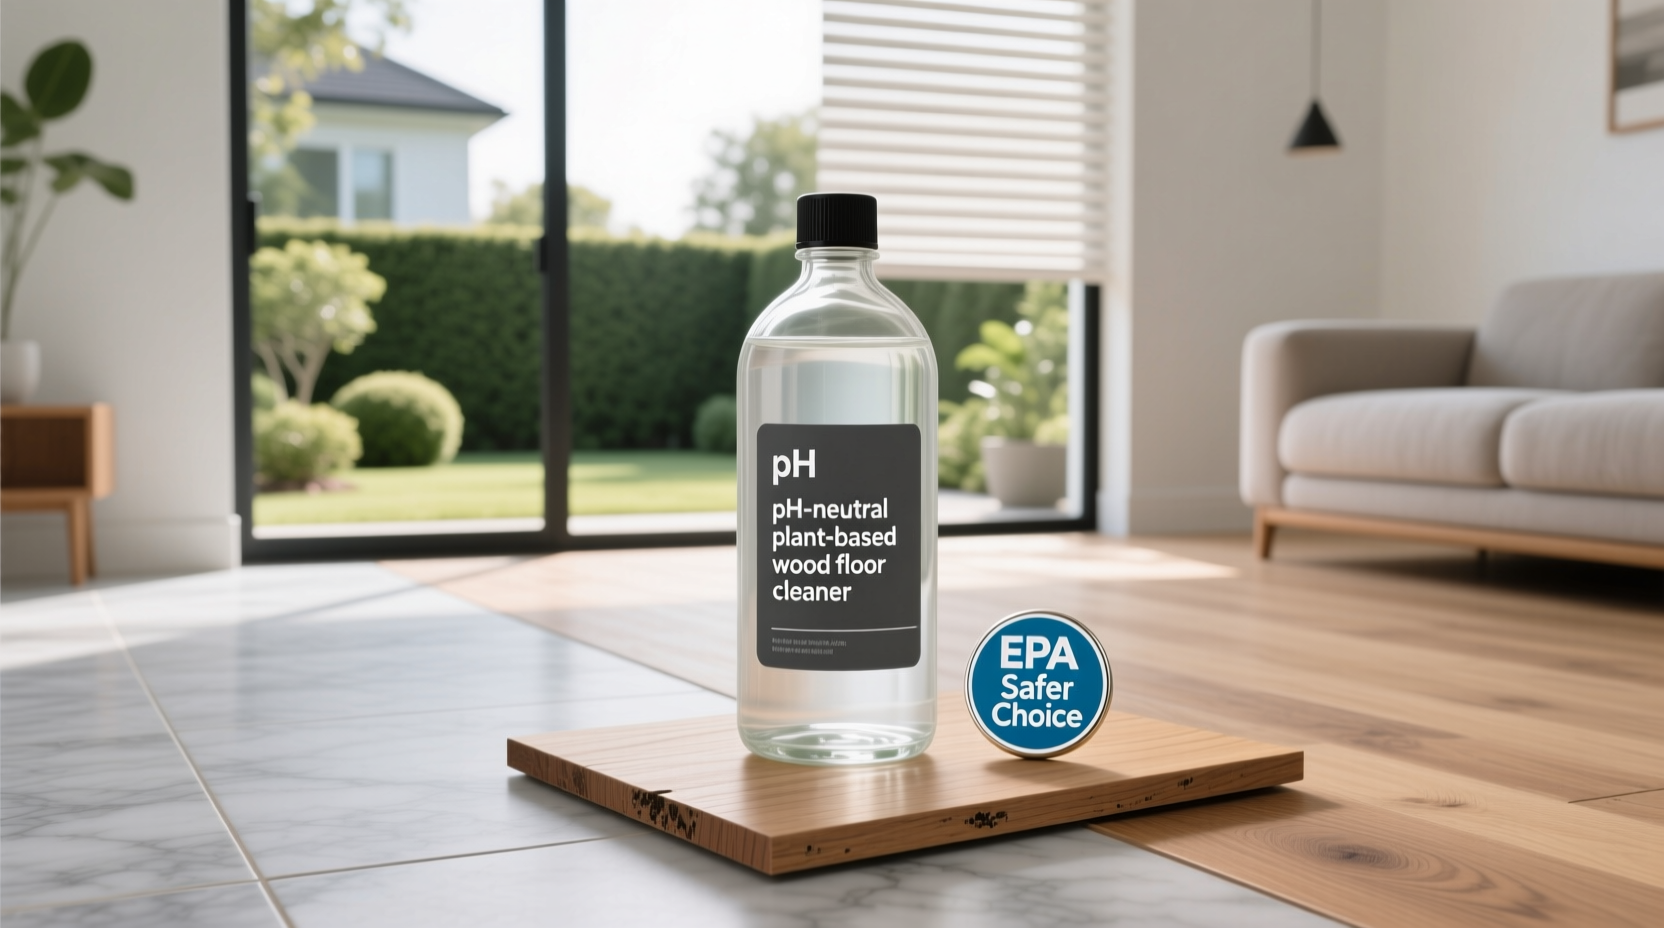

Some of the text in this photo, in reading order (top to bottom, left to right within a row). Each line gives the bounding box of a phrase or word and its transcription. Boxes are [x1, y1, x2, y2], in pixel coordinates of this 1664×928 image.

[772, 448, 816, 486] pH
[772, 497, 888, 525] pH-neutral
[772, 525, 897, 553] plant-based
[771, 553, 887, 575] wood floor
[772, 579, 852, 602] cleaner
[1000, 635, 1079, 670] EPA
[1000, 673, 1074, 701] Safer
[991, 701, 1084, 728] Choice
